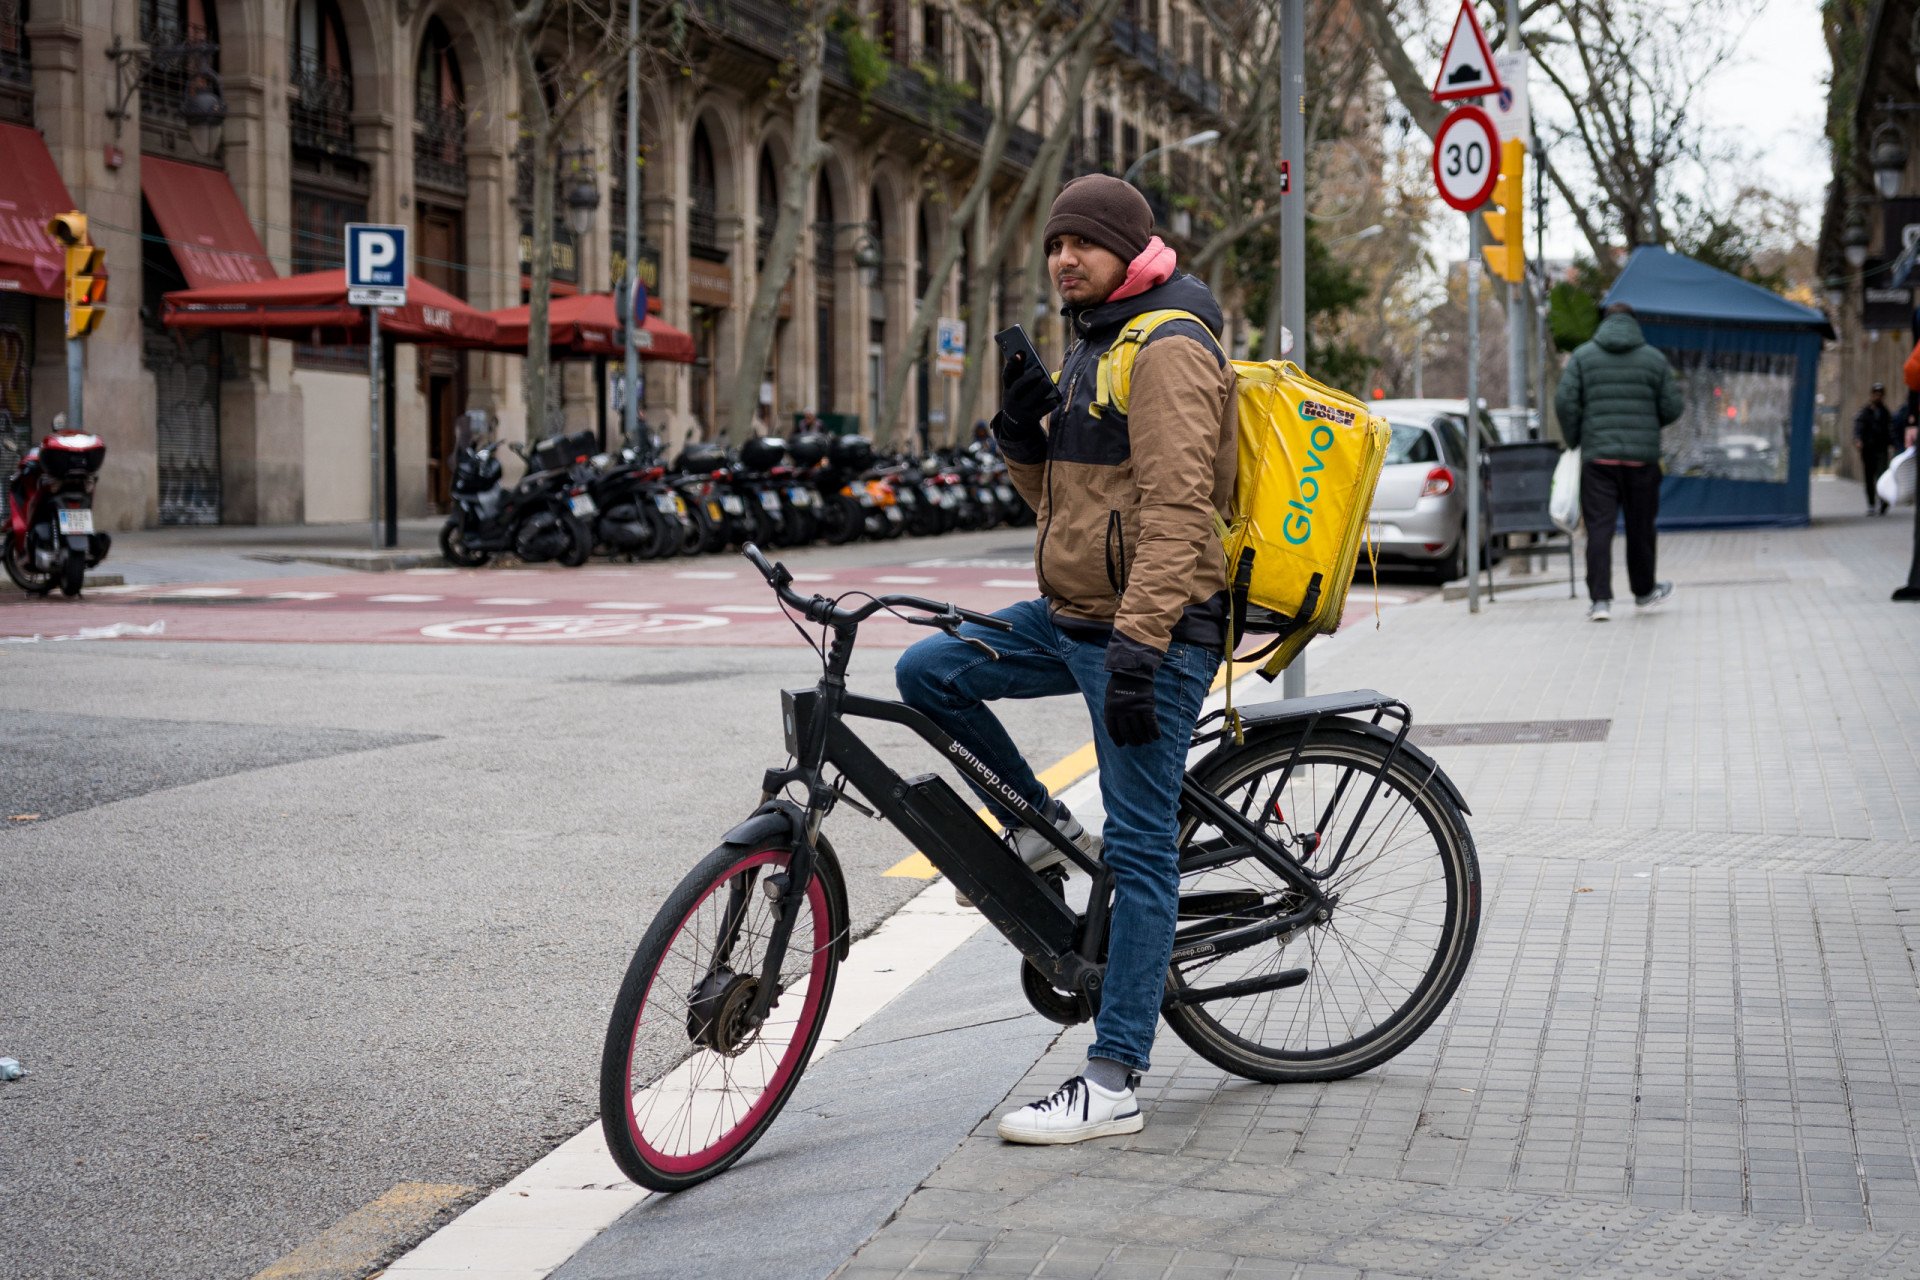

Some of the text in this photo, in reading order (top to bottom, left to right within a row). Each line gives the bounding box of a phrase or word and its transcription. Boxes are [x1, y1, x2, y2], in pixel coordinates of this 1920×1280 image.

[1447, 142, 1483, 176] 30
[358, 230, 397, 283] P
[1304, 400, 1355, 420] SMASH
[1304, 407, 1353, 427] HOUSE
[1283, 424, 1335, 545] Glovo
[948, 740, 1029, 811] gomeep.com
[1461, 839, 1474, 882] PROTECTION
[1171, 945, 1212, 959] omeep.com
